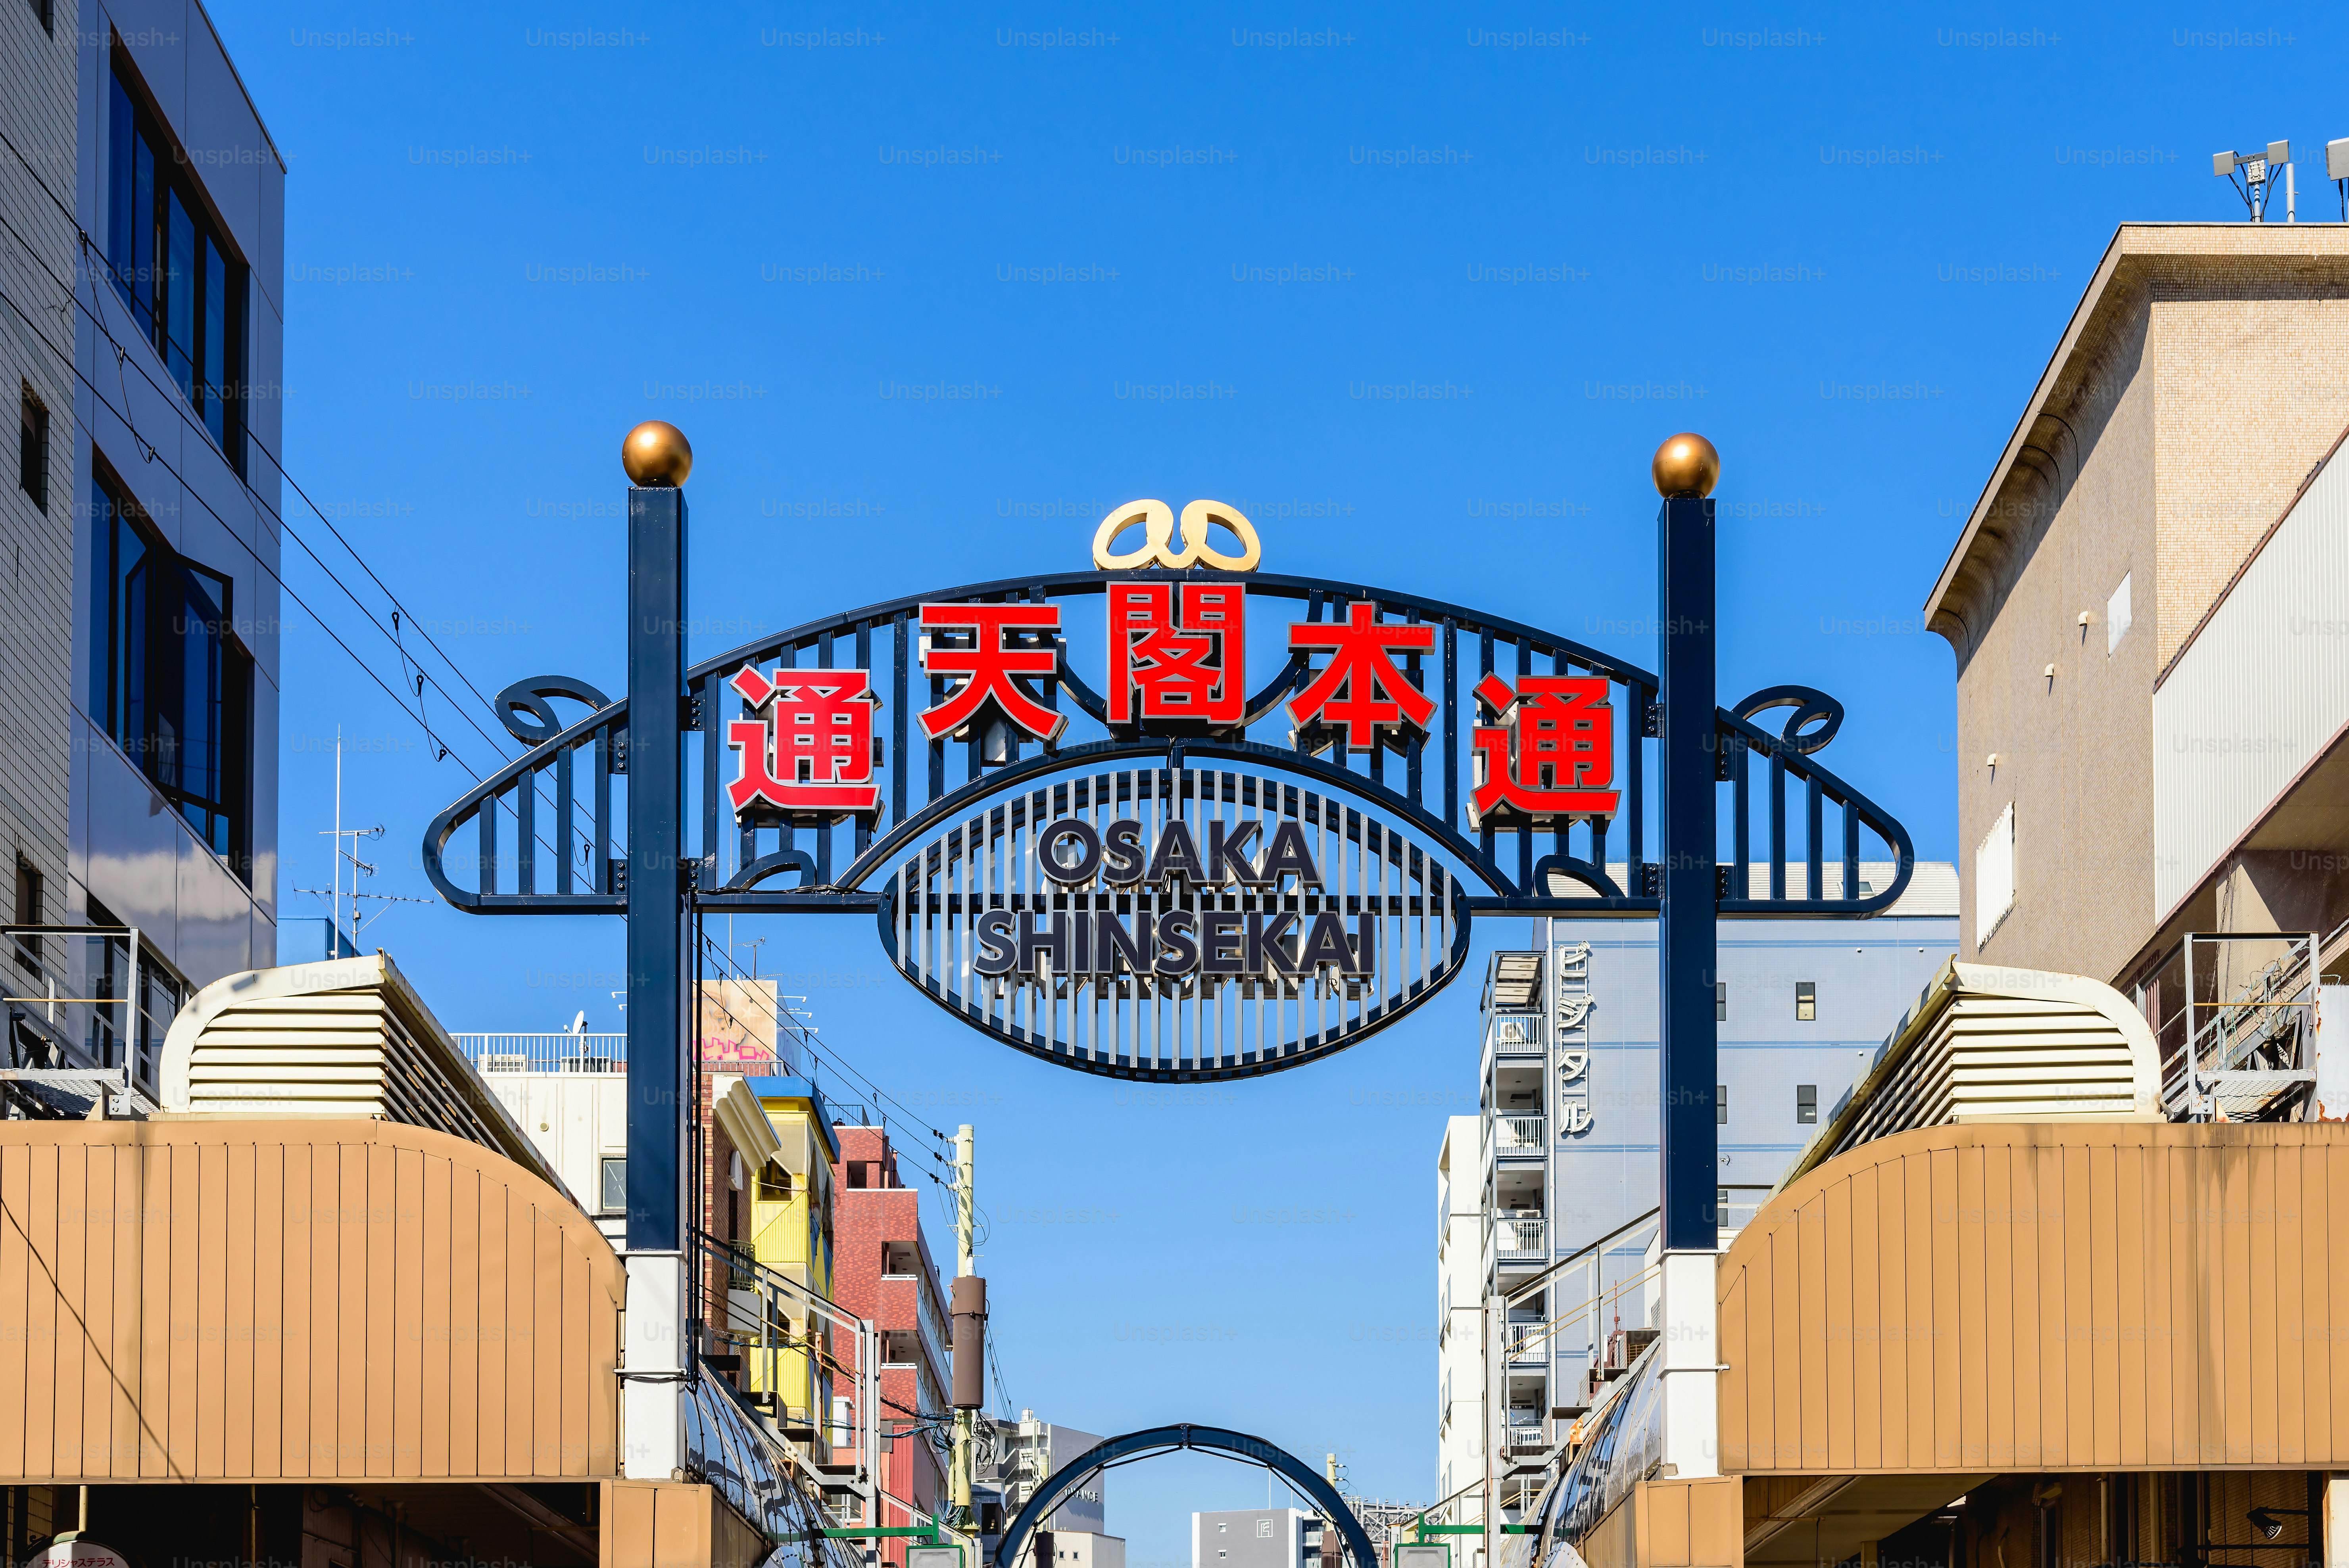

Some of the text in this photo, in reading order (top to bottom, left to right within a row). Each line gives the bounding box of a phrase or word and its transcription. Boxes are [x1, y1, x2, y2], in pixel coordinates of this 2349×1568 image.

[1038, 818, 1321, 887] OSAKA
[973, 908, 1375, 977] SHINSEKAI
[1063, 1487, 1098, 1502] DVANCE
[42, 1557, 115, 1568] デリシャステラス
